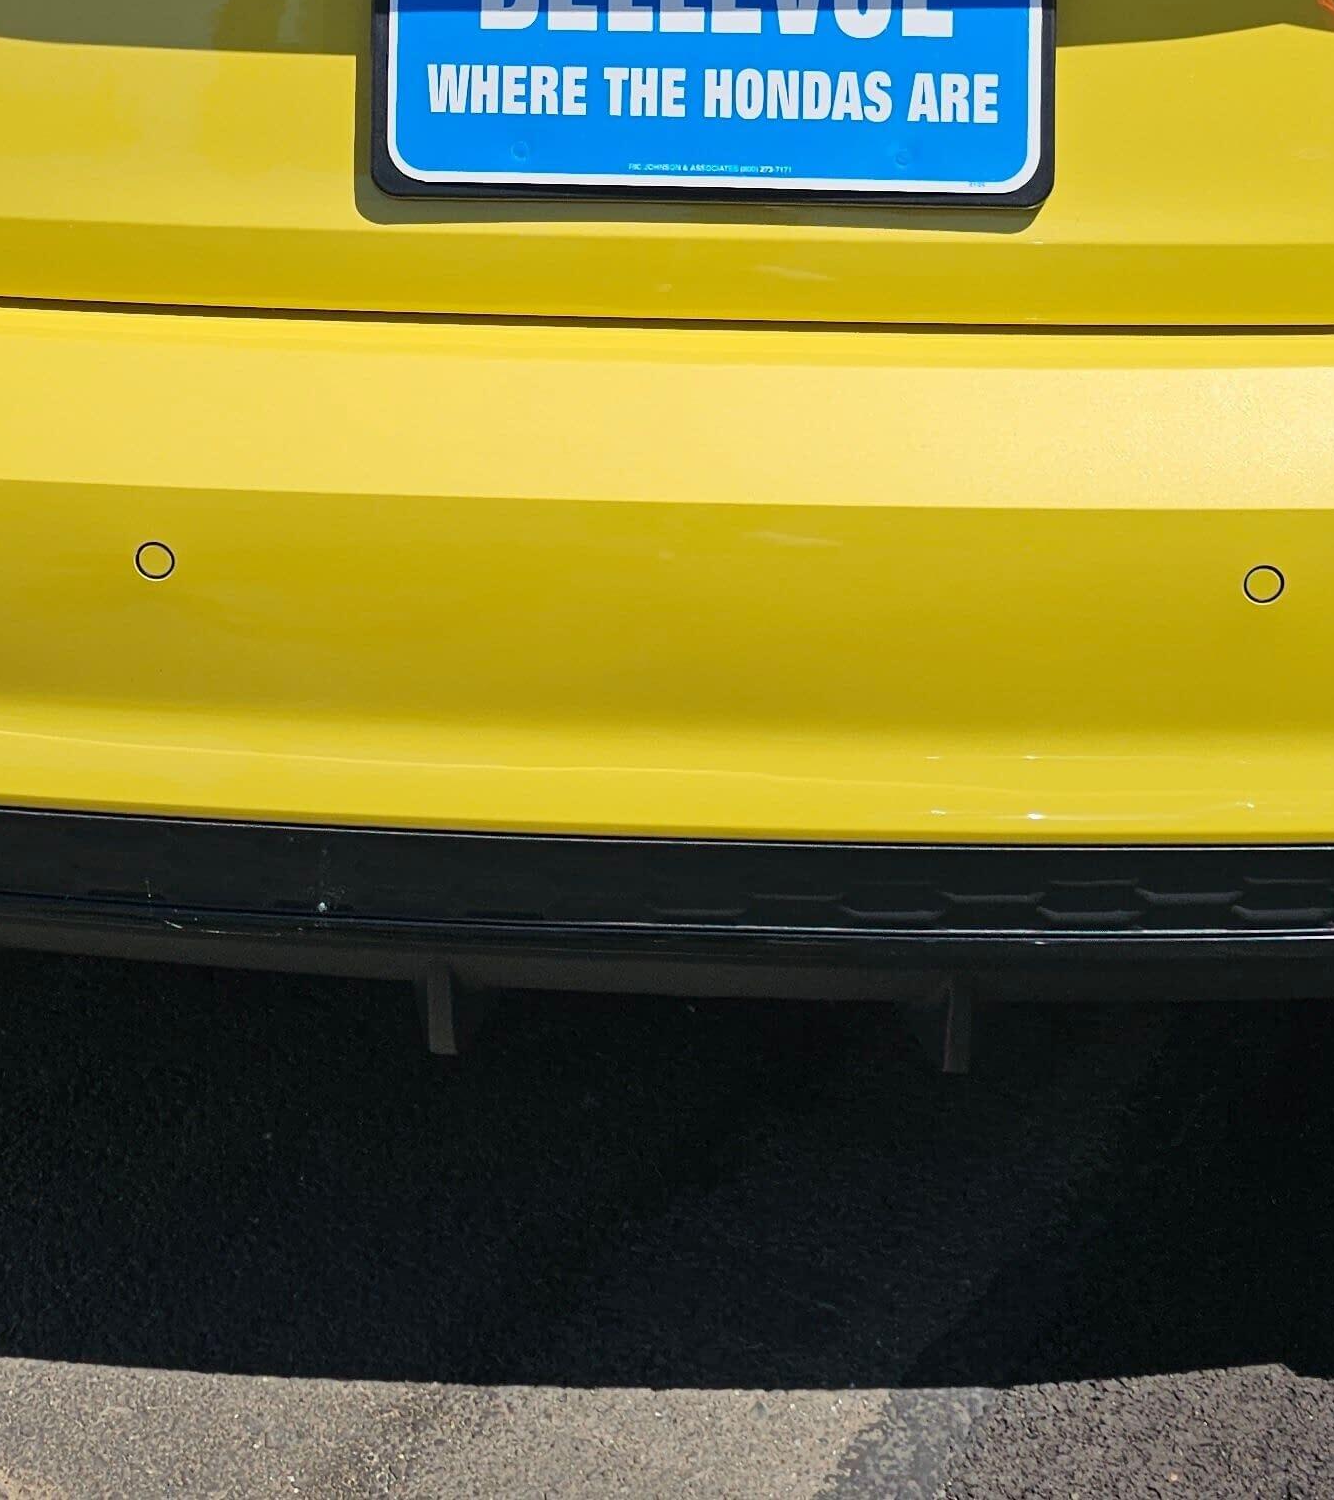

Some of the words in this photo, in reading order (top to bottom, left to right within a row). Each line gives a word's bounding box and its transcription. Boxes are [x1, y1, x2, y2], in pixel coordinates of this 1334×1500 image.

[427, 63, 588, 116] WHERE
[603, 67, 687, 118] THE
[704, 68, 893, 123] HONDAS
[907, 72, 999, 124] ARE
